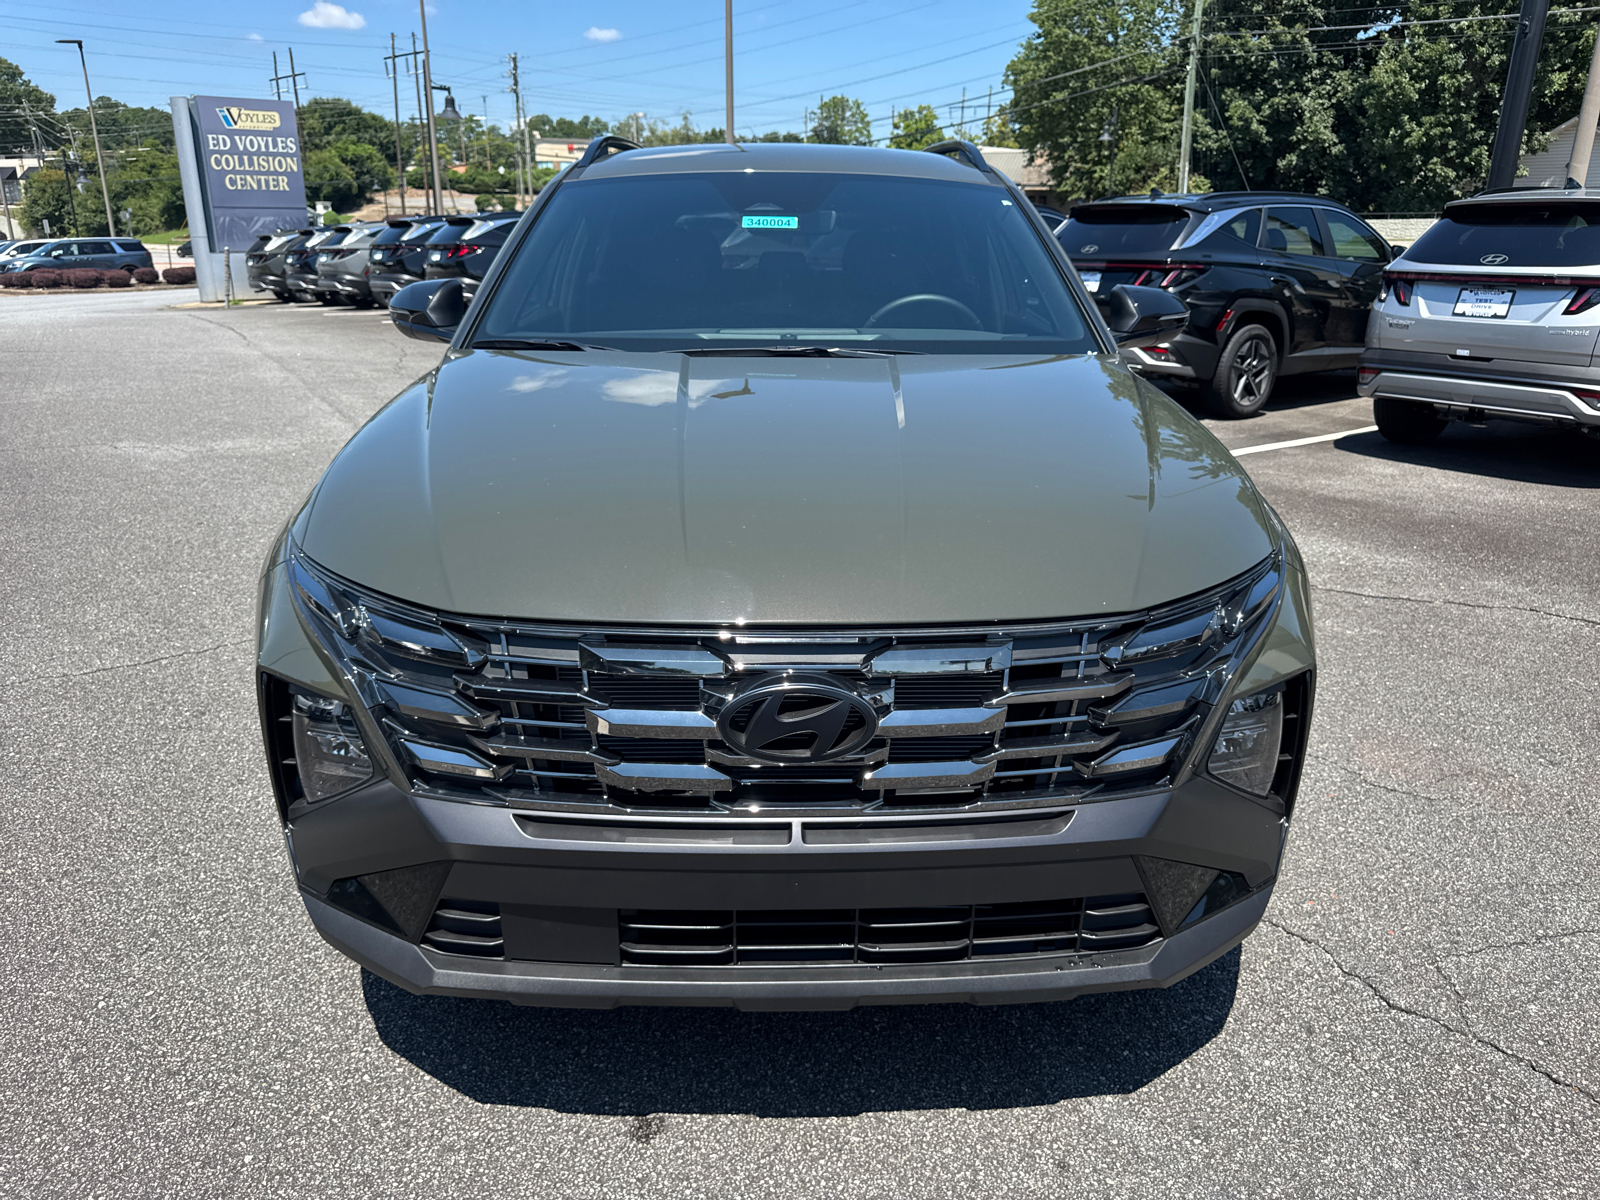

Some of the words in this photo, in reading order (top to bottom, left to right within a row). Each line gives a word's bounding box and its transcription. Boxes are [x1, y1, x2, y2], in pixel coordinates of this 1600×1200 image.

[207, 134, 231, 151] ED
[234, 135, 297, 153] VOYLES
[210, 154, 298, 172] COLLISION
[225, 174, 290, 191] CENTER
[747, 218, 791, 227] 340004
[1566, 329, 1590, 337] hybrid
